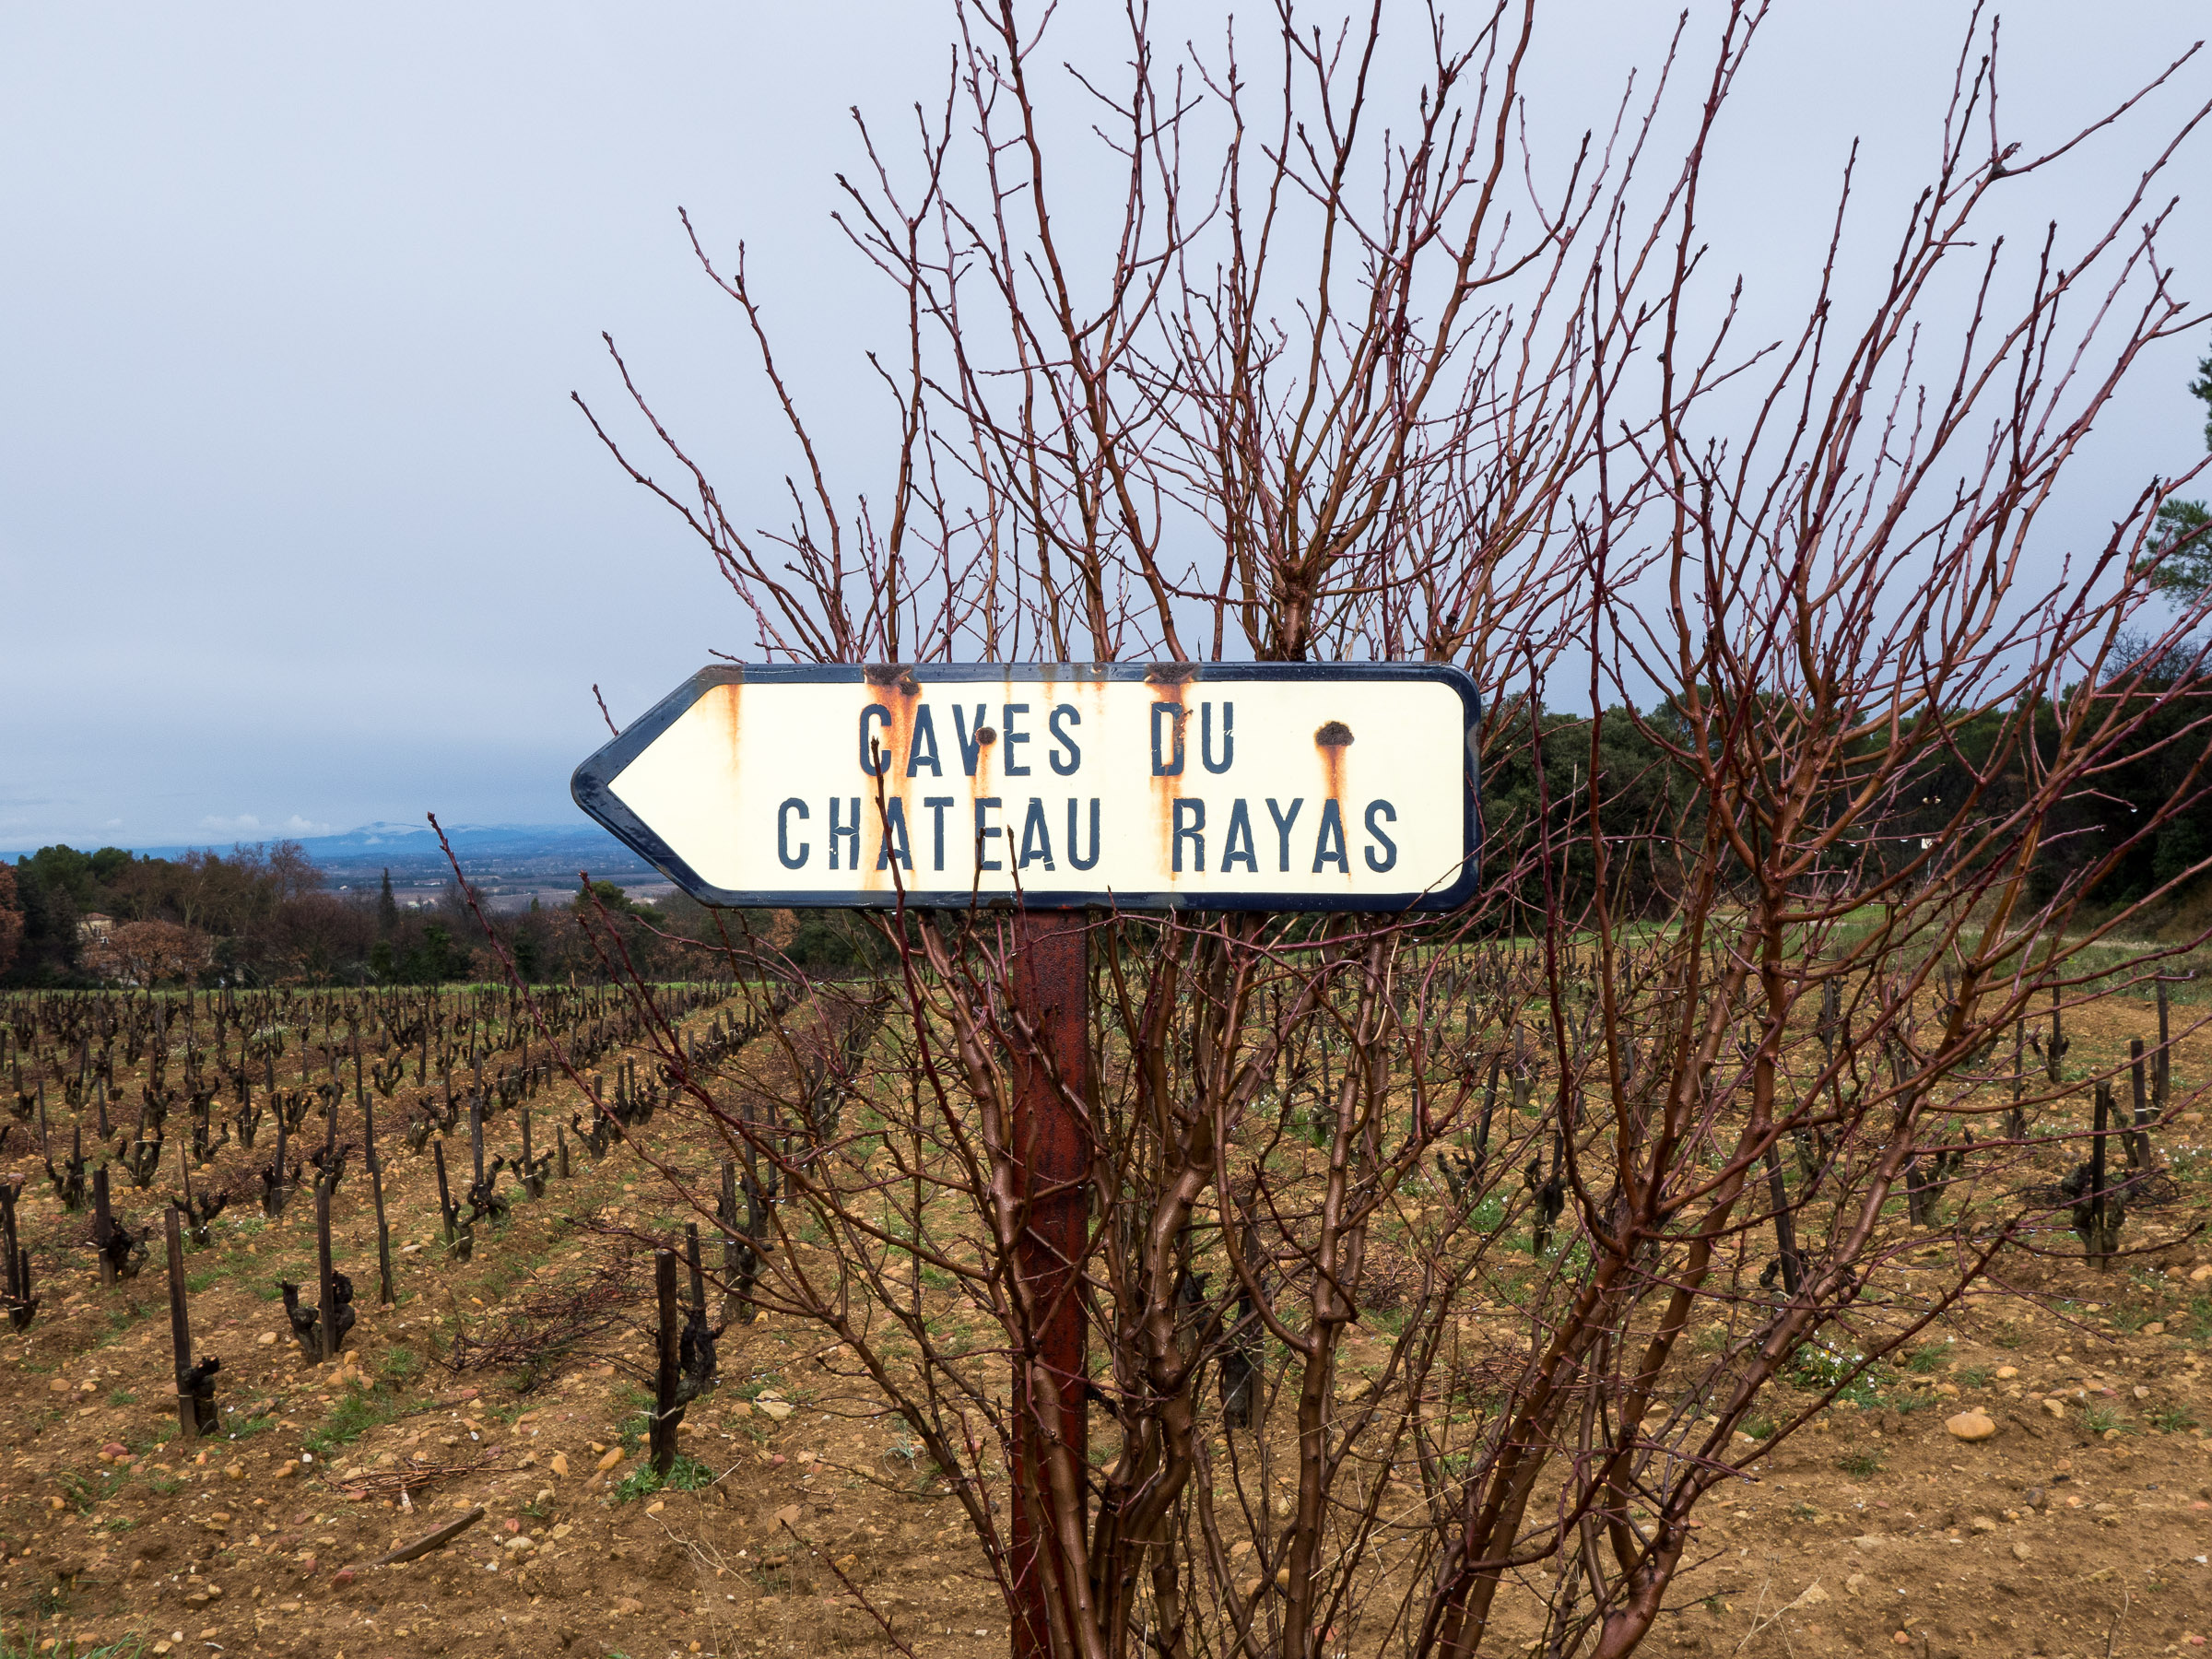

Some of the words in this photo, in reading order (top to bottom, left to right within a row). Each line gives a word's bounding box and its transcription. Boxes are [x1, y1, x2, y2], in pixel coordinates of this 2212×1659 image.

[859, 703, 1081, 776] CAVES
[1151, 701, 1234, 776] DU
[777, 796, 1100, 871] CHATEAU
[1171, 798, 1397, 873] RAYAS
